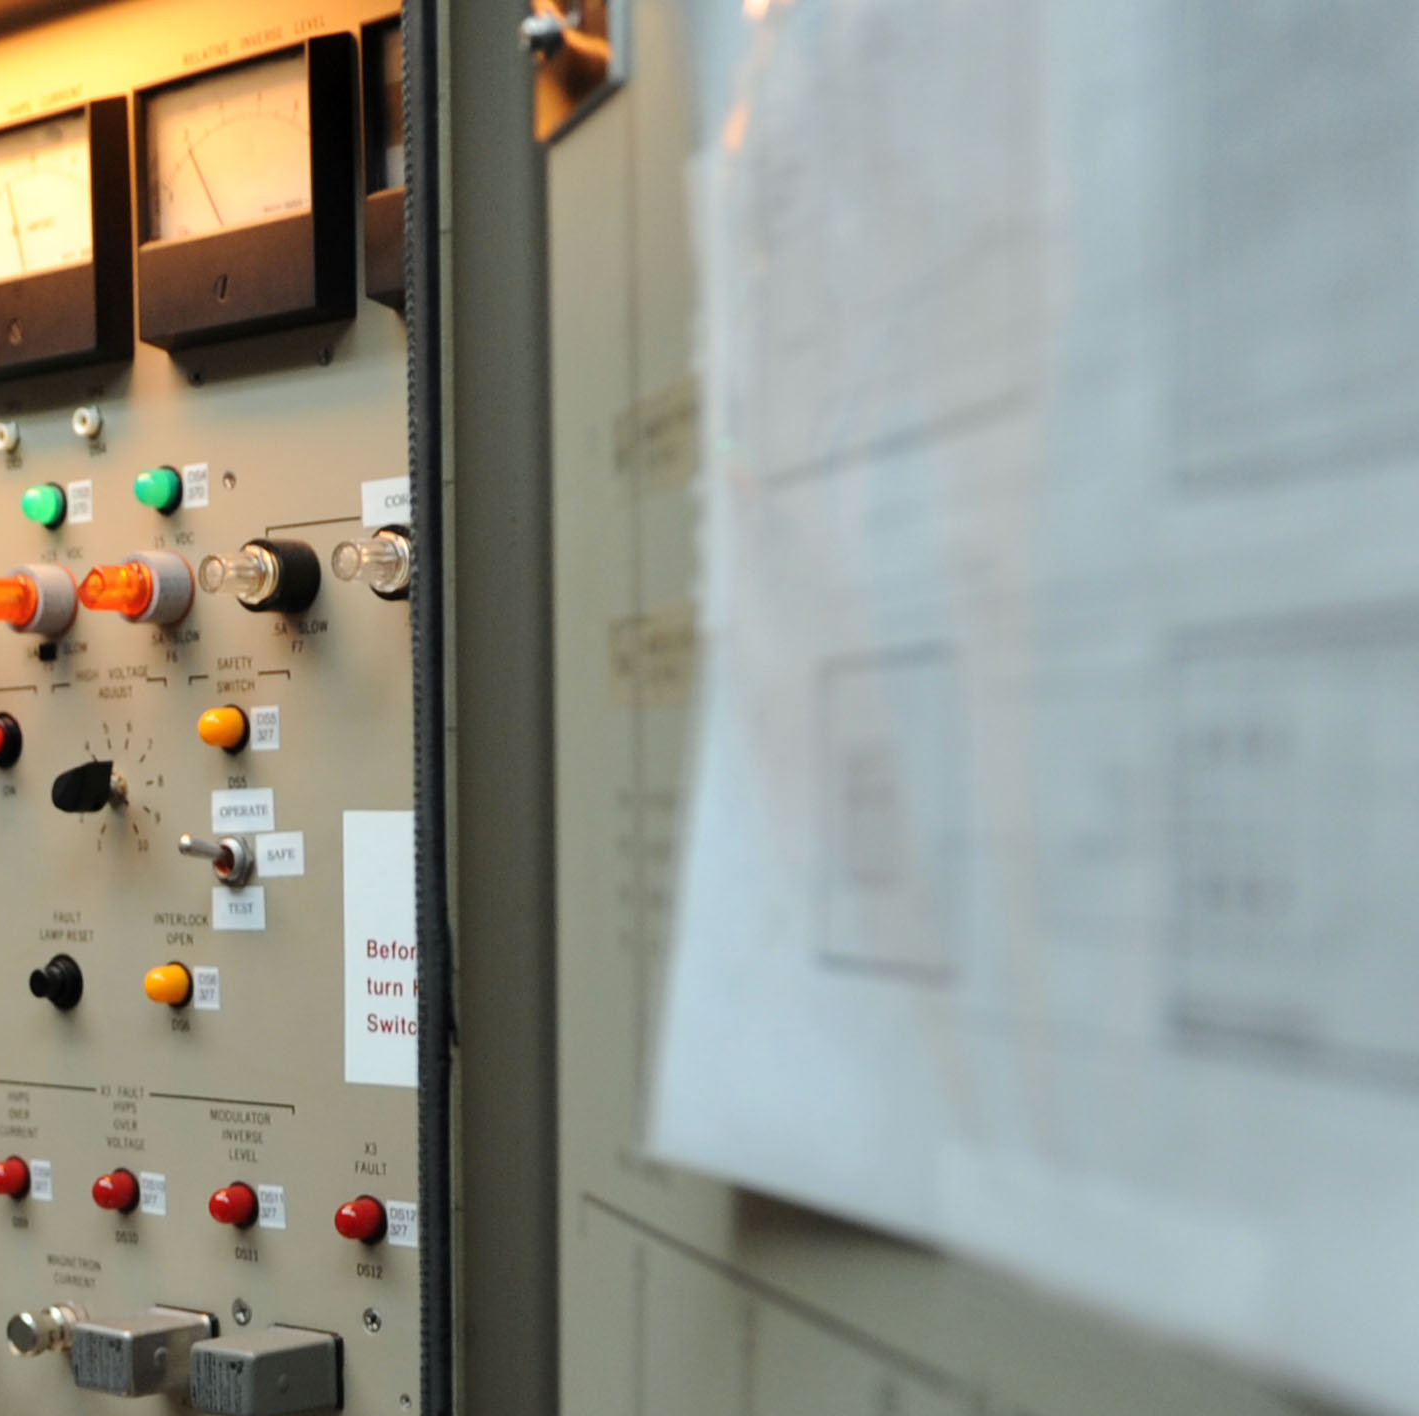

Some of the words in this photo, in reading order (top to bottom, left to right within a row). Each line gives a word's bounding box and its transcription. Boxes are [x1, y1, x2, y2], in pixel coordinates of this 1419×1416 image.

[182, 39, 229, 66] RELATIVE
[239, 25, 283, 50] INVERSE
[293, 14, 326, 34] LEVEL
[216, 656, 252, 671] SAFETY
[109, 664, 149, 680] VOLTAGE
[99, 684, 132, 699] ADJUST
[216, 680, 255, 695] SWITCH
[220, 804, 269, 818] OPERATE
[267, 848, 296, 862] SAFE
[228, 902, 253, 915] TEST
[153, 912, 209, 928] INTERLOCK
[166, 932, 194, 946] OPEN
[366, 977, 404, 997] turn
[118, 1085, 145, 1100] FAULT
[210, 1109, 272, 1127] MODULATOR
[106, 1136, 146, 1152] VOLTAGE
[222, 1130, 264, 1146] INVERSE
[228, 1150, 259, 1164] LEVEL
[354, 1161, 388, 1177] FAULT
[356, 1263, 384, 1280] DS12
